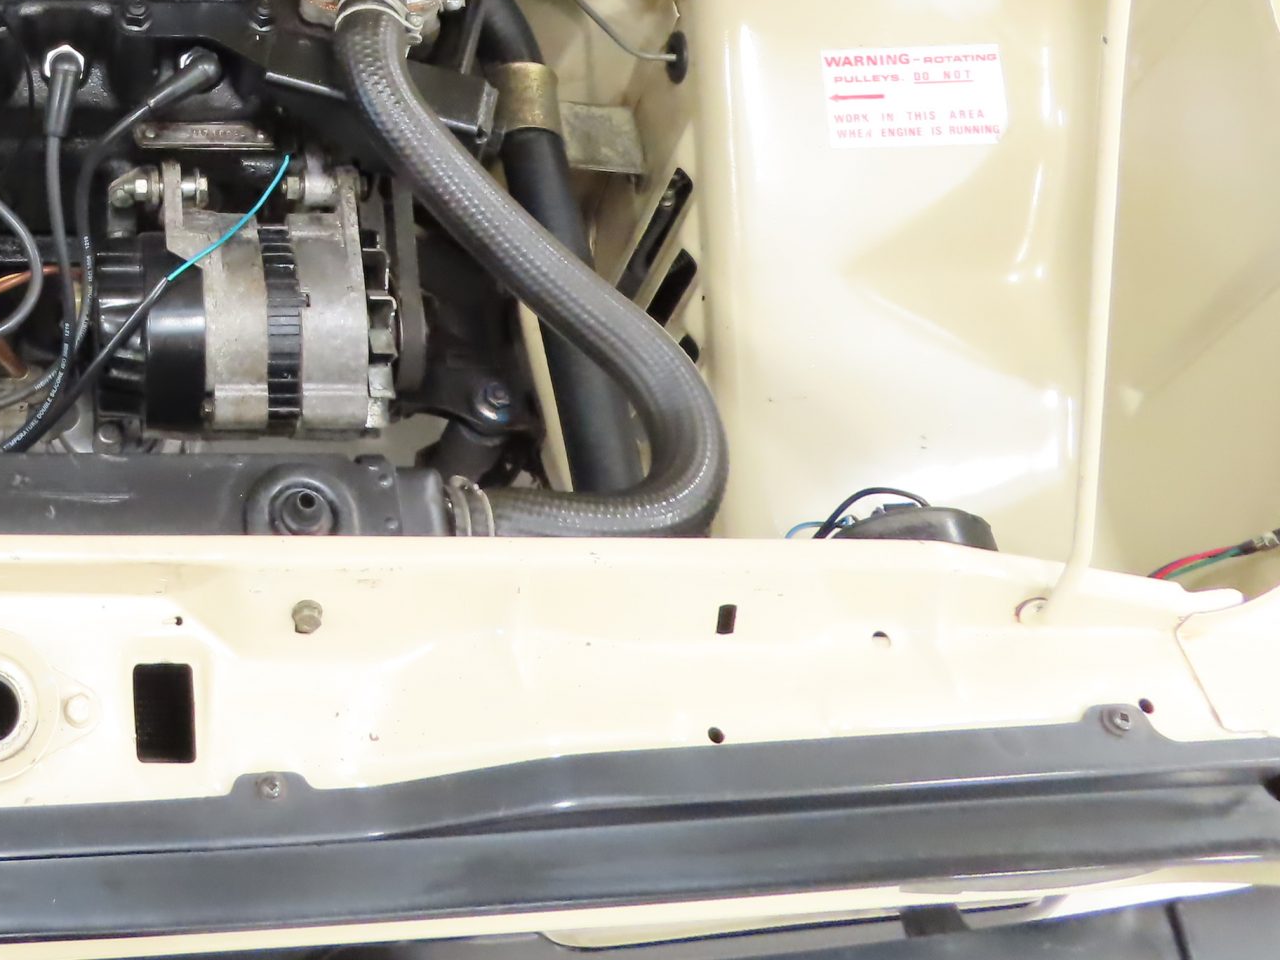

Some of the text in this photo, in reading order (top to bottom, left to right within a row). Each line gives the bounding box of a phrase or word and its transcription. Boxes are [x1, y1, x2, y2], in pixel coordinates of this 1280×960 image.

[824, 53, 910, 67] WARNING
[923, 53, 998, 64] ROTATING
[913, 71, 930, 81] DO
[943, 70, 972, 80] NOT
[833, 109, 984, 123] WORK IN THIS AREA
[881, 127, 923, 137] ENGINE
[931, 126, 943, 136] IS
[949, 125, 1001, 135] RUNNING
[36, 398, 53, 419] DOUBLE
[50, 371, 64, 398] SILICONE
